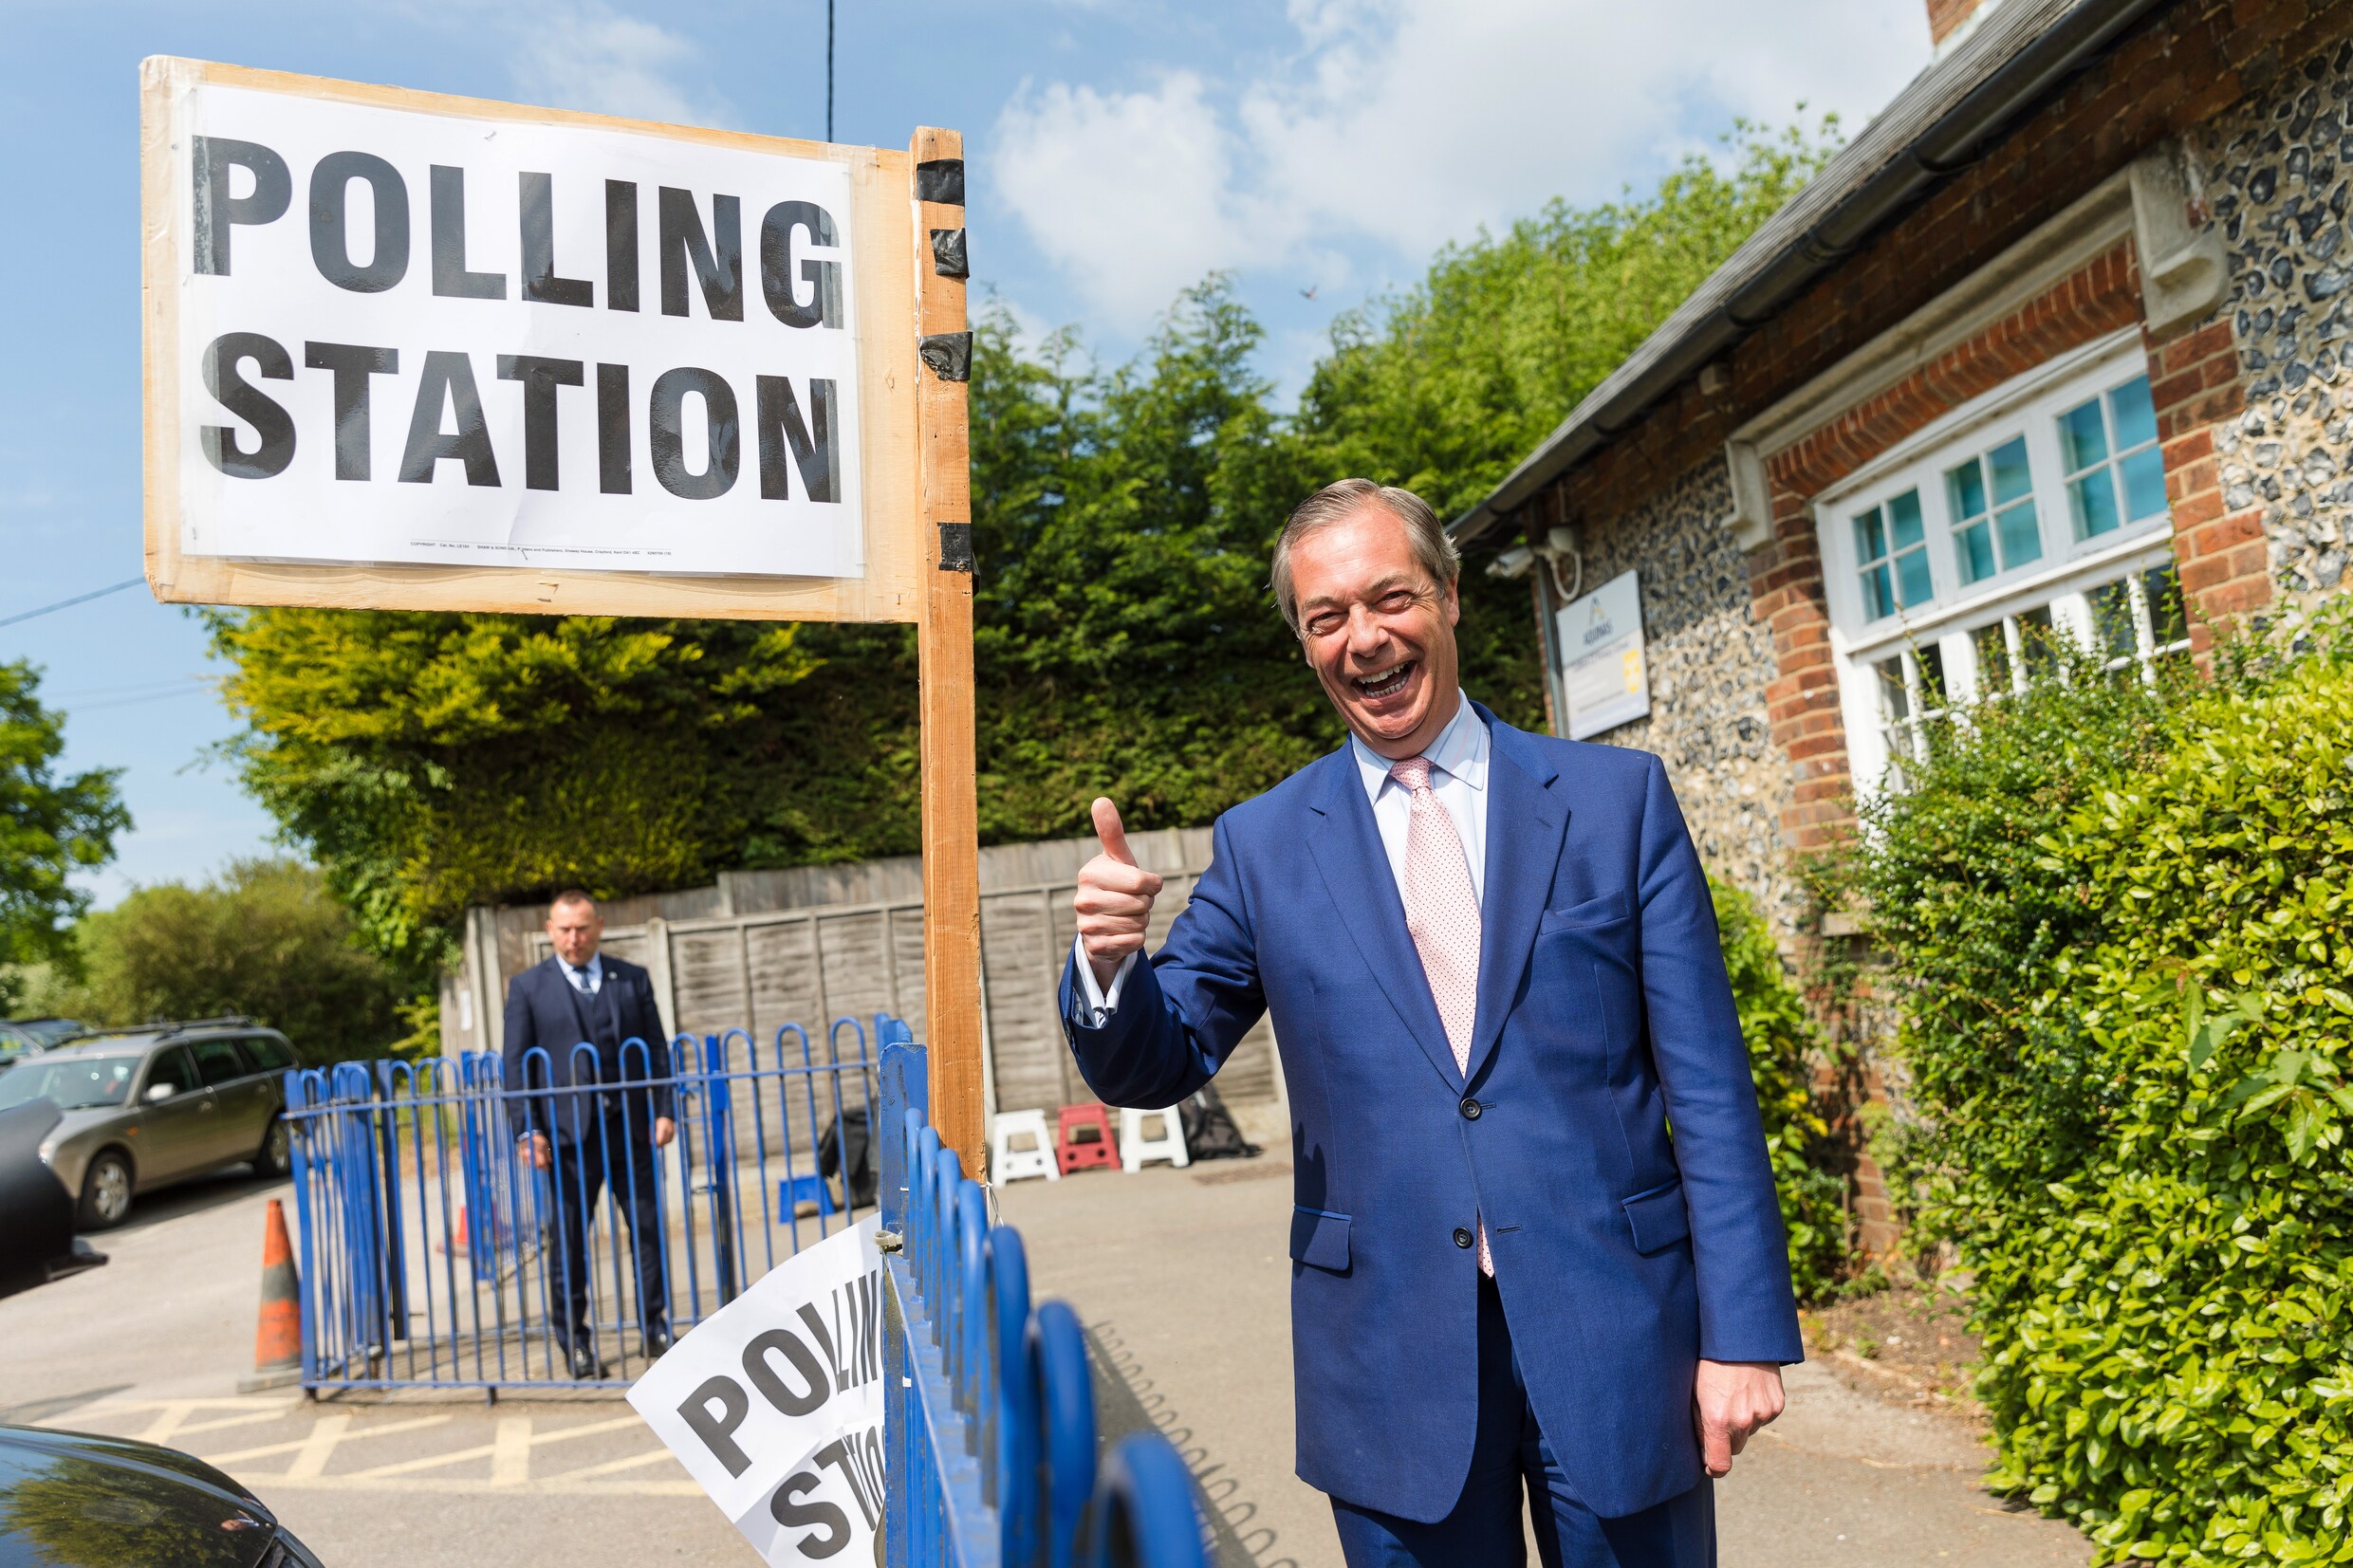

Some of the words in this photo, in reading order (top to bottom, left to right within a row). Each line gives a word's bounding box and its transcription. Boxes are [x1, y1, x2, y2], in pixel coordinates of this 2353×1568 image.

[193, 134, 843, 330] POLLING
[199, 331, 842, 505] STATION
[676, 1269, 886, 1480] POLLIN
[770, 1425, 886, 1560] STIO
